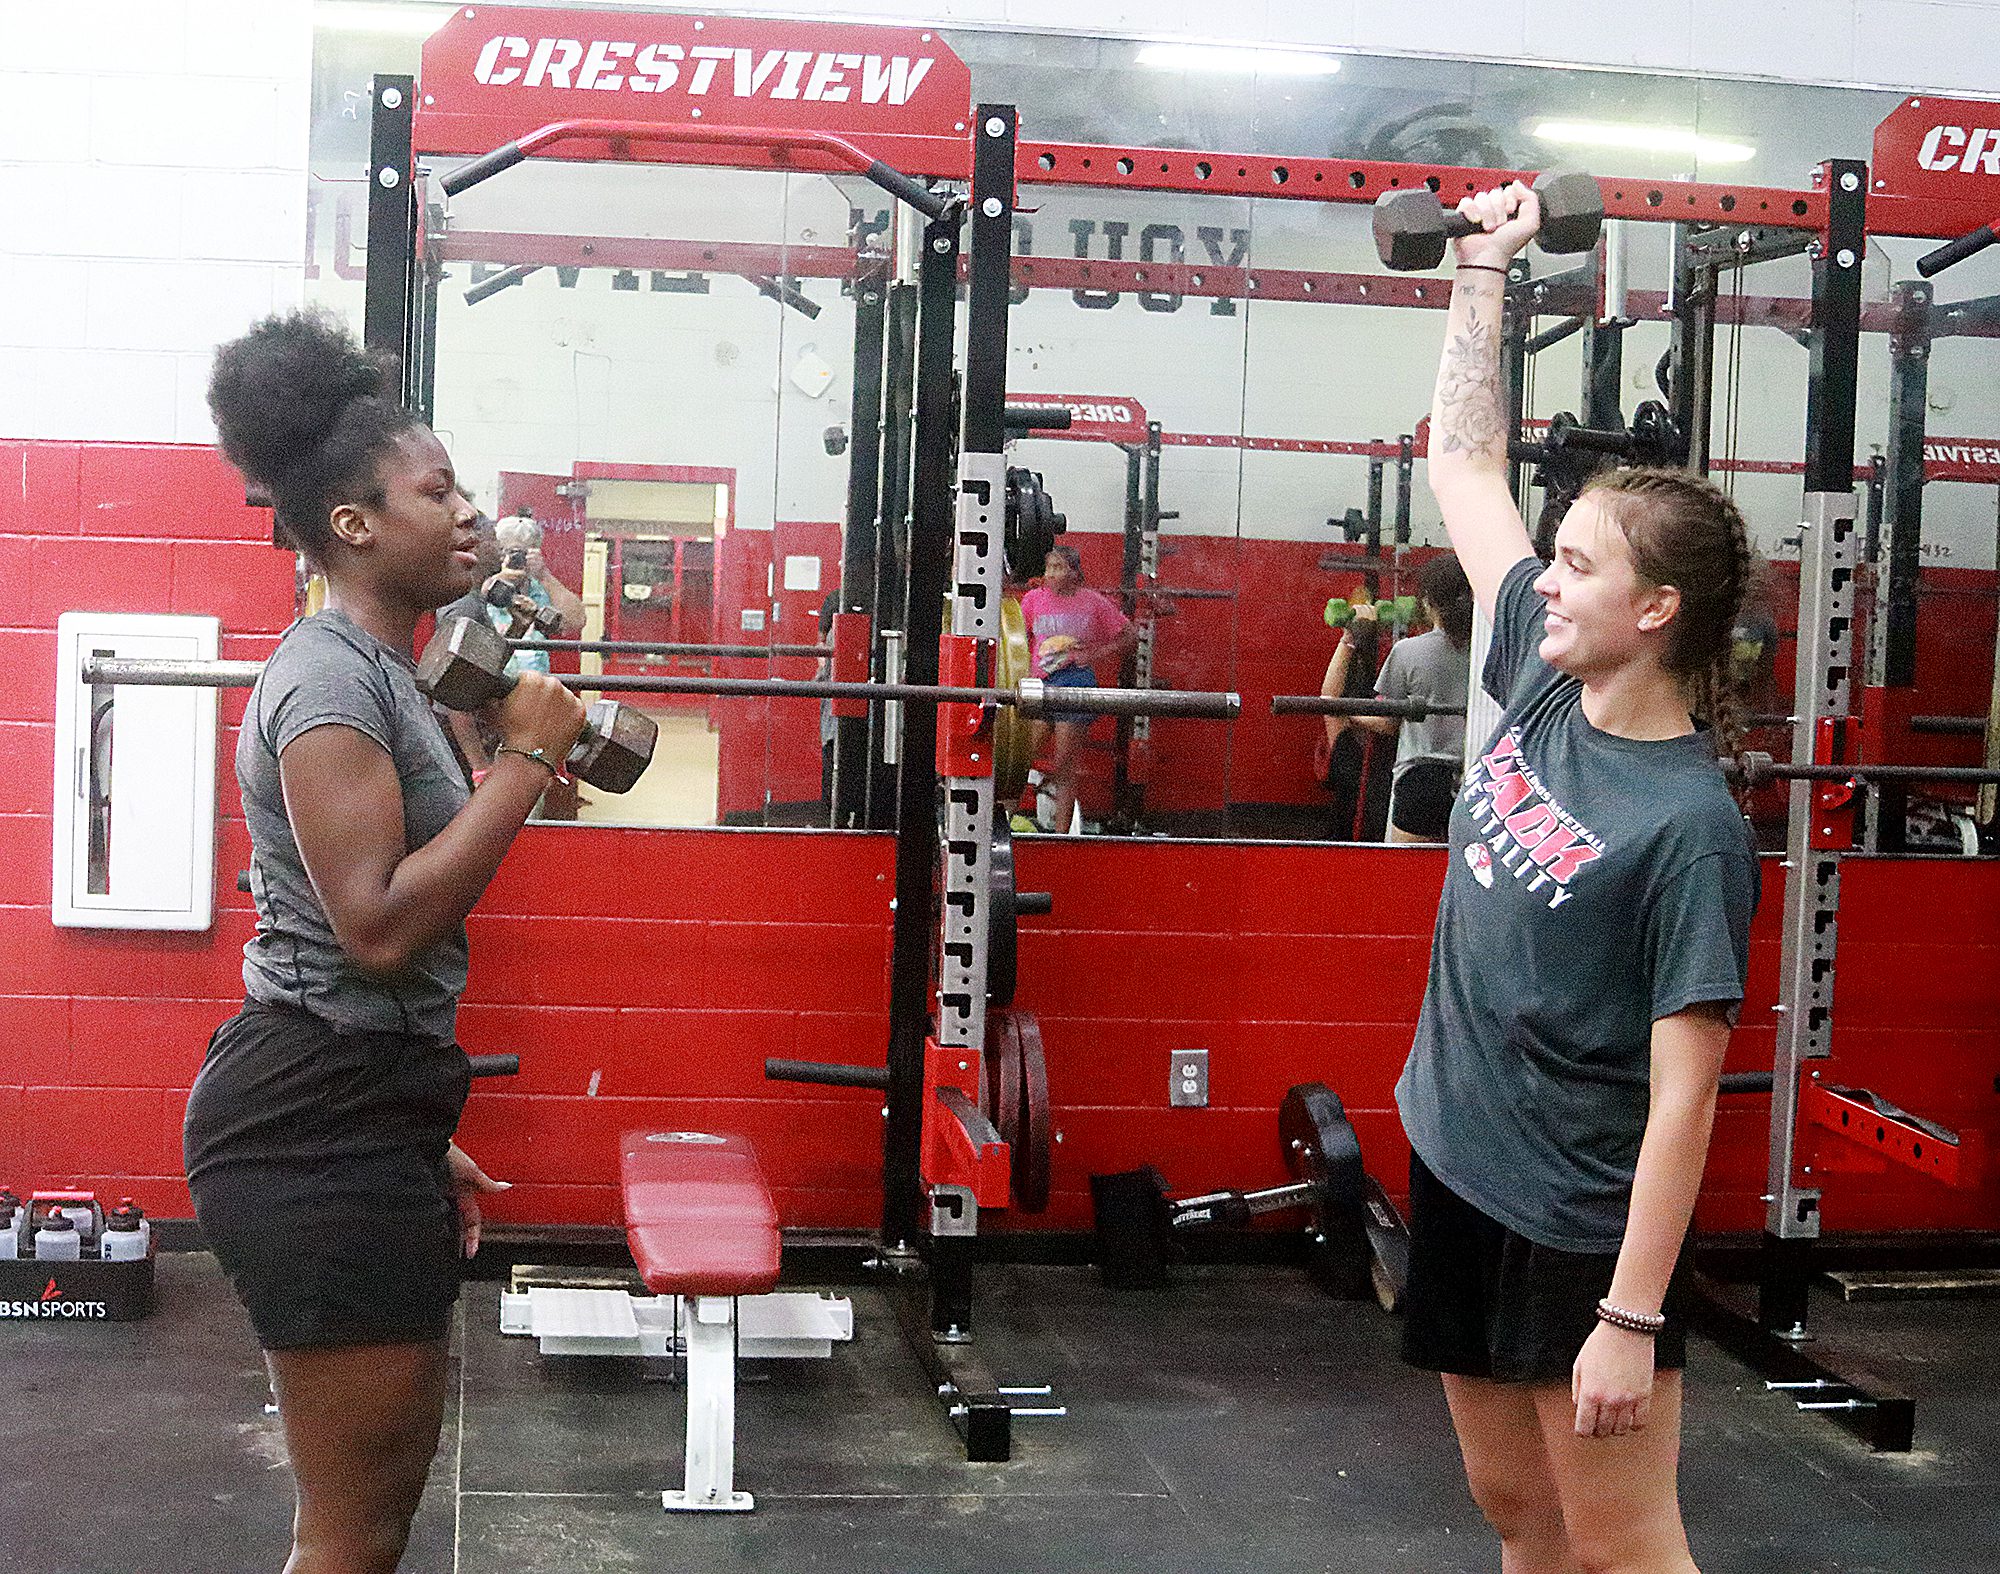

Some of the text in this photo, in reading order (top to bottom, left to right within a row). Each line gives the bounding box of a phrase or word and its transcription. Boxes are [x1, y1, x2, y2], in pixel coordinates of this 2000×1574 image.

[473, 36, 934, 105] CRESTVIEW
[1464, 761, 1573, 909] MENTALITY
[1548, 799, 1606, 853] BASKETBALL
